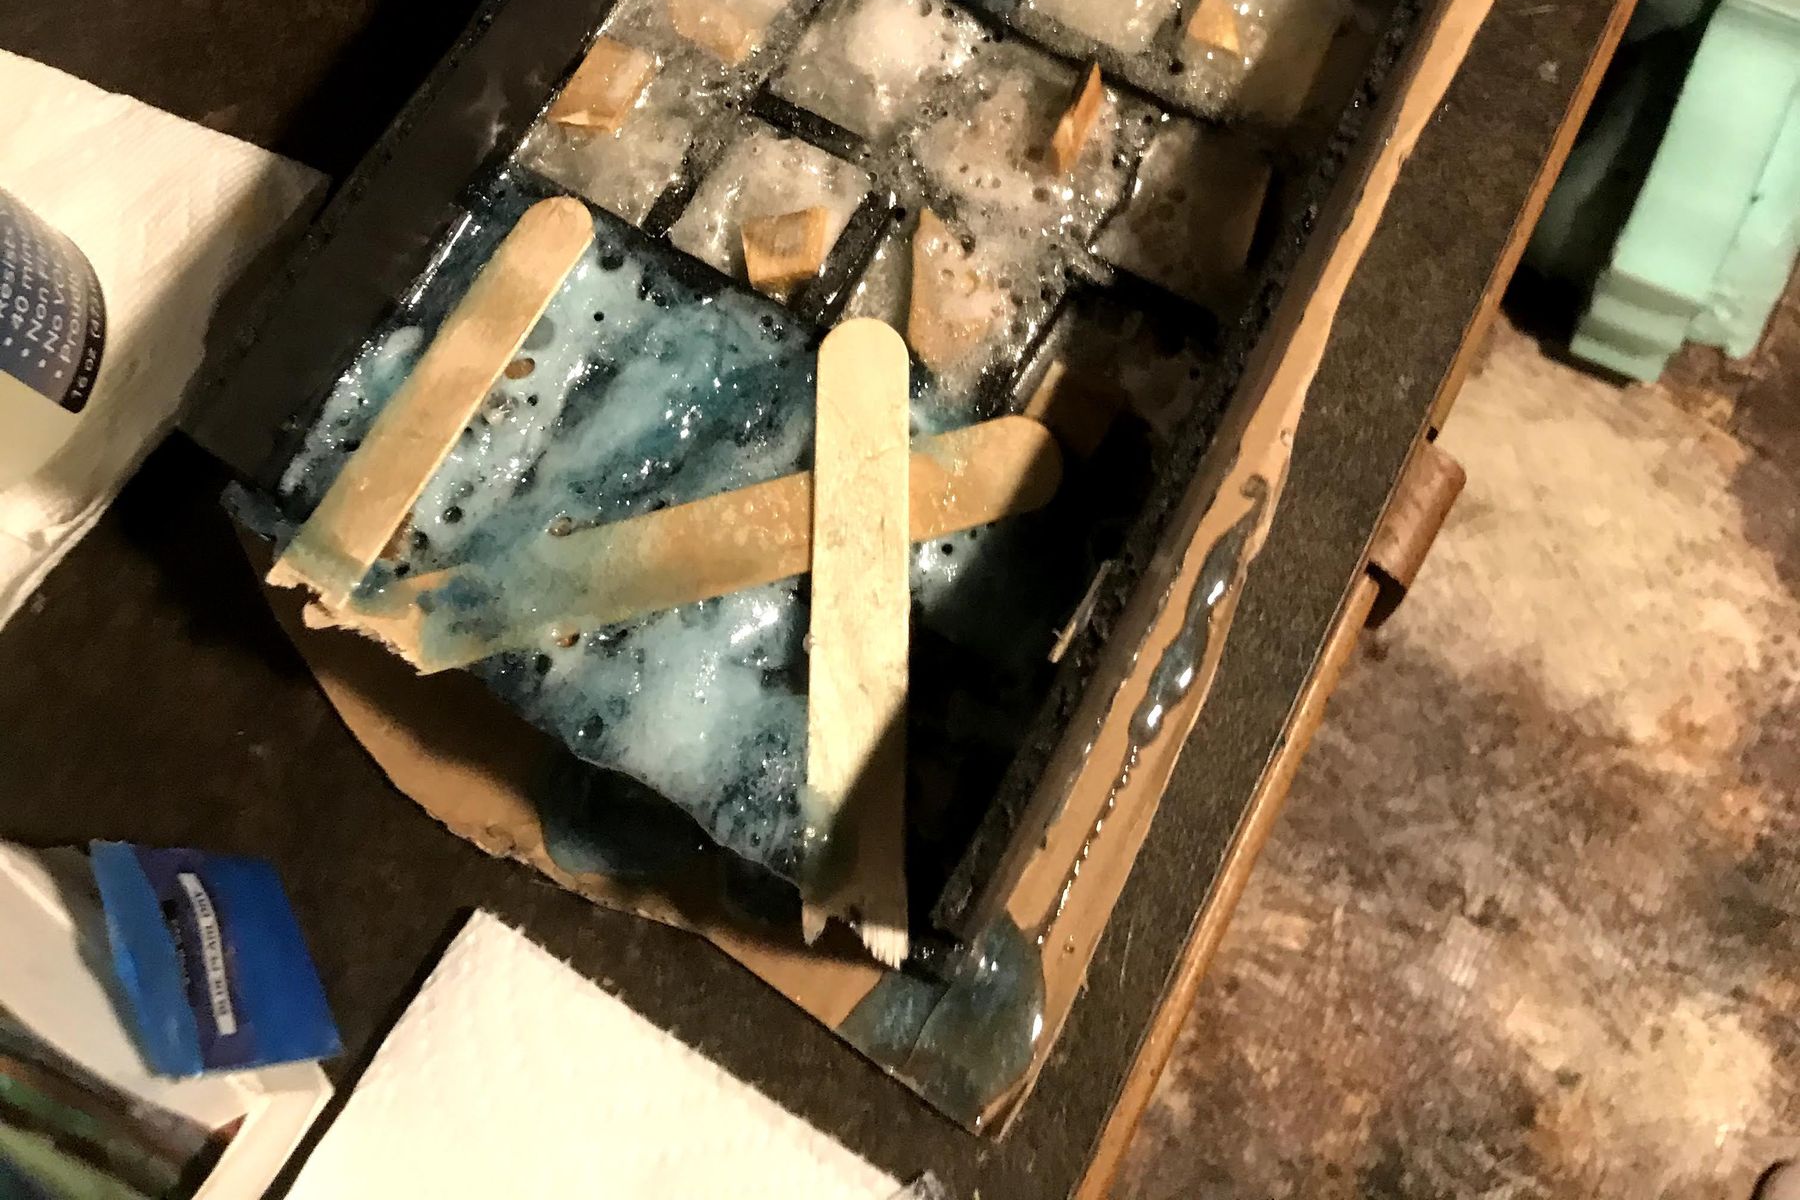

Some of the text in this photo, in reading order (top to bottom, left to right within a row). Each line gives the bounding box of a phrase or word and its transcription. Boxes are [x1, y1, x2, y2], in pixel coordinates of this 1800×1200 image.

[11, 295, 30, 331] 40
[27, 287, 50, 342] Non
[42, 313, 64, 353] No
